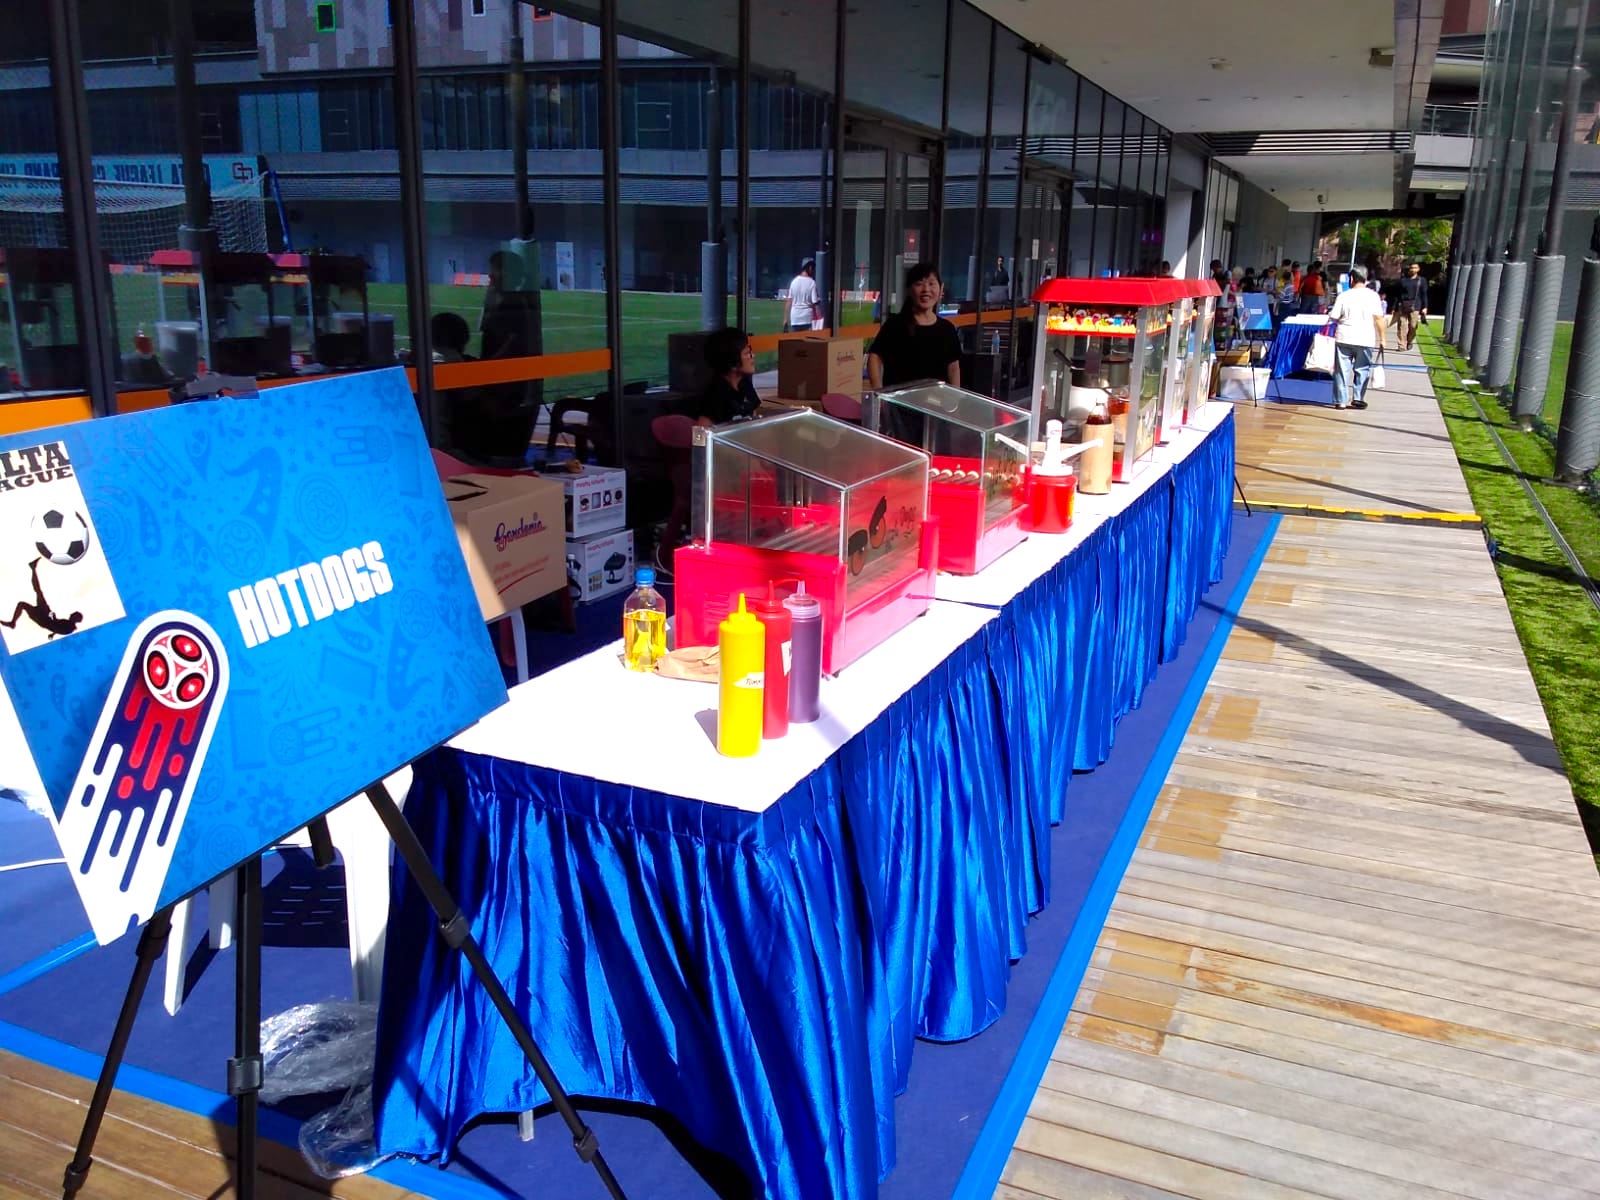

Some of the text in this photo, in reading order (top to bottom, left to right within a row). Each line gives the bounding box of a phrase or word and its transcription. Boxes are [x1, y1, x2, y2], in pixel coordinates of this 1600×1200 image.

[0, 443, 71, 478] LTA
[0, 466, 74, 492] AGUE
[228, 541, 394, 649] HOTDOGS
